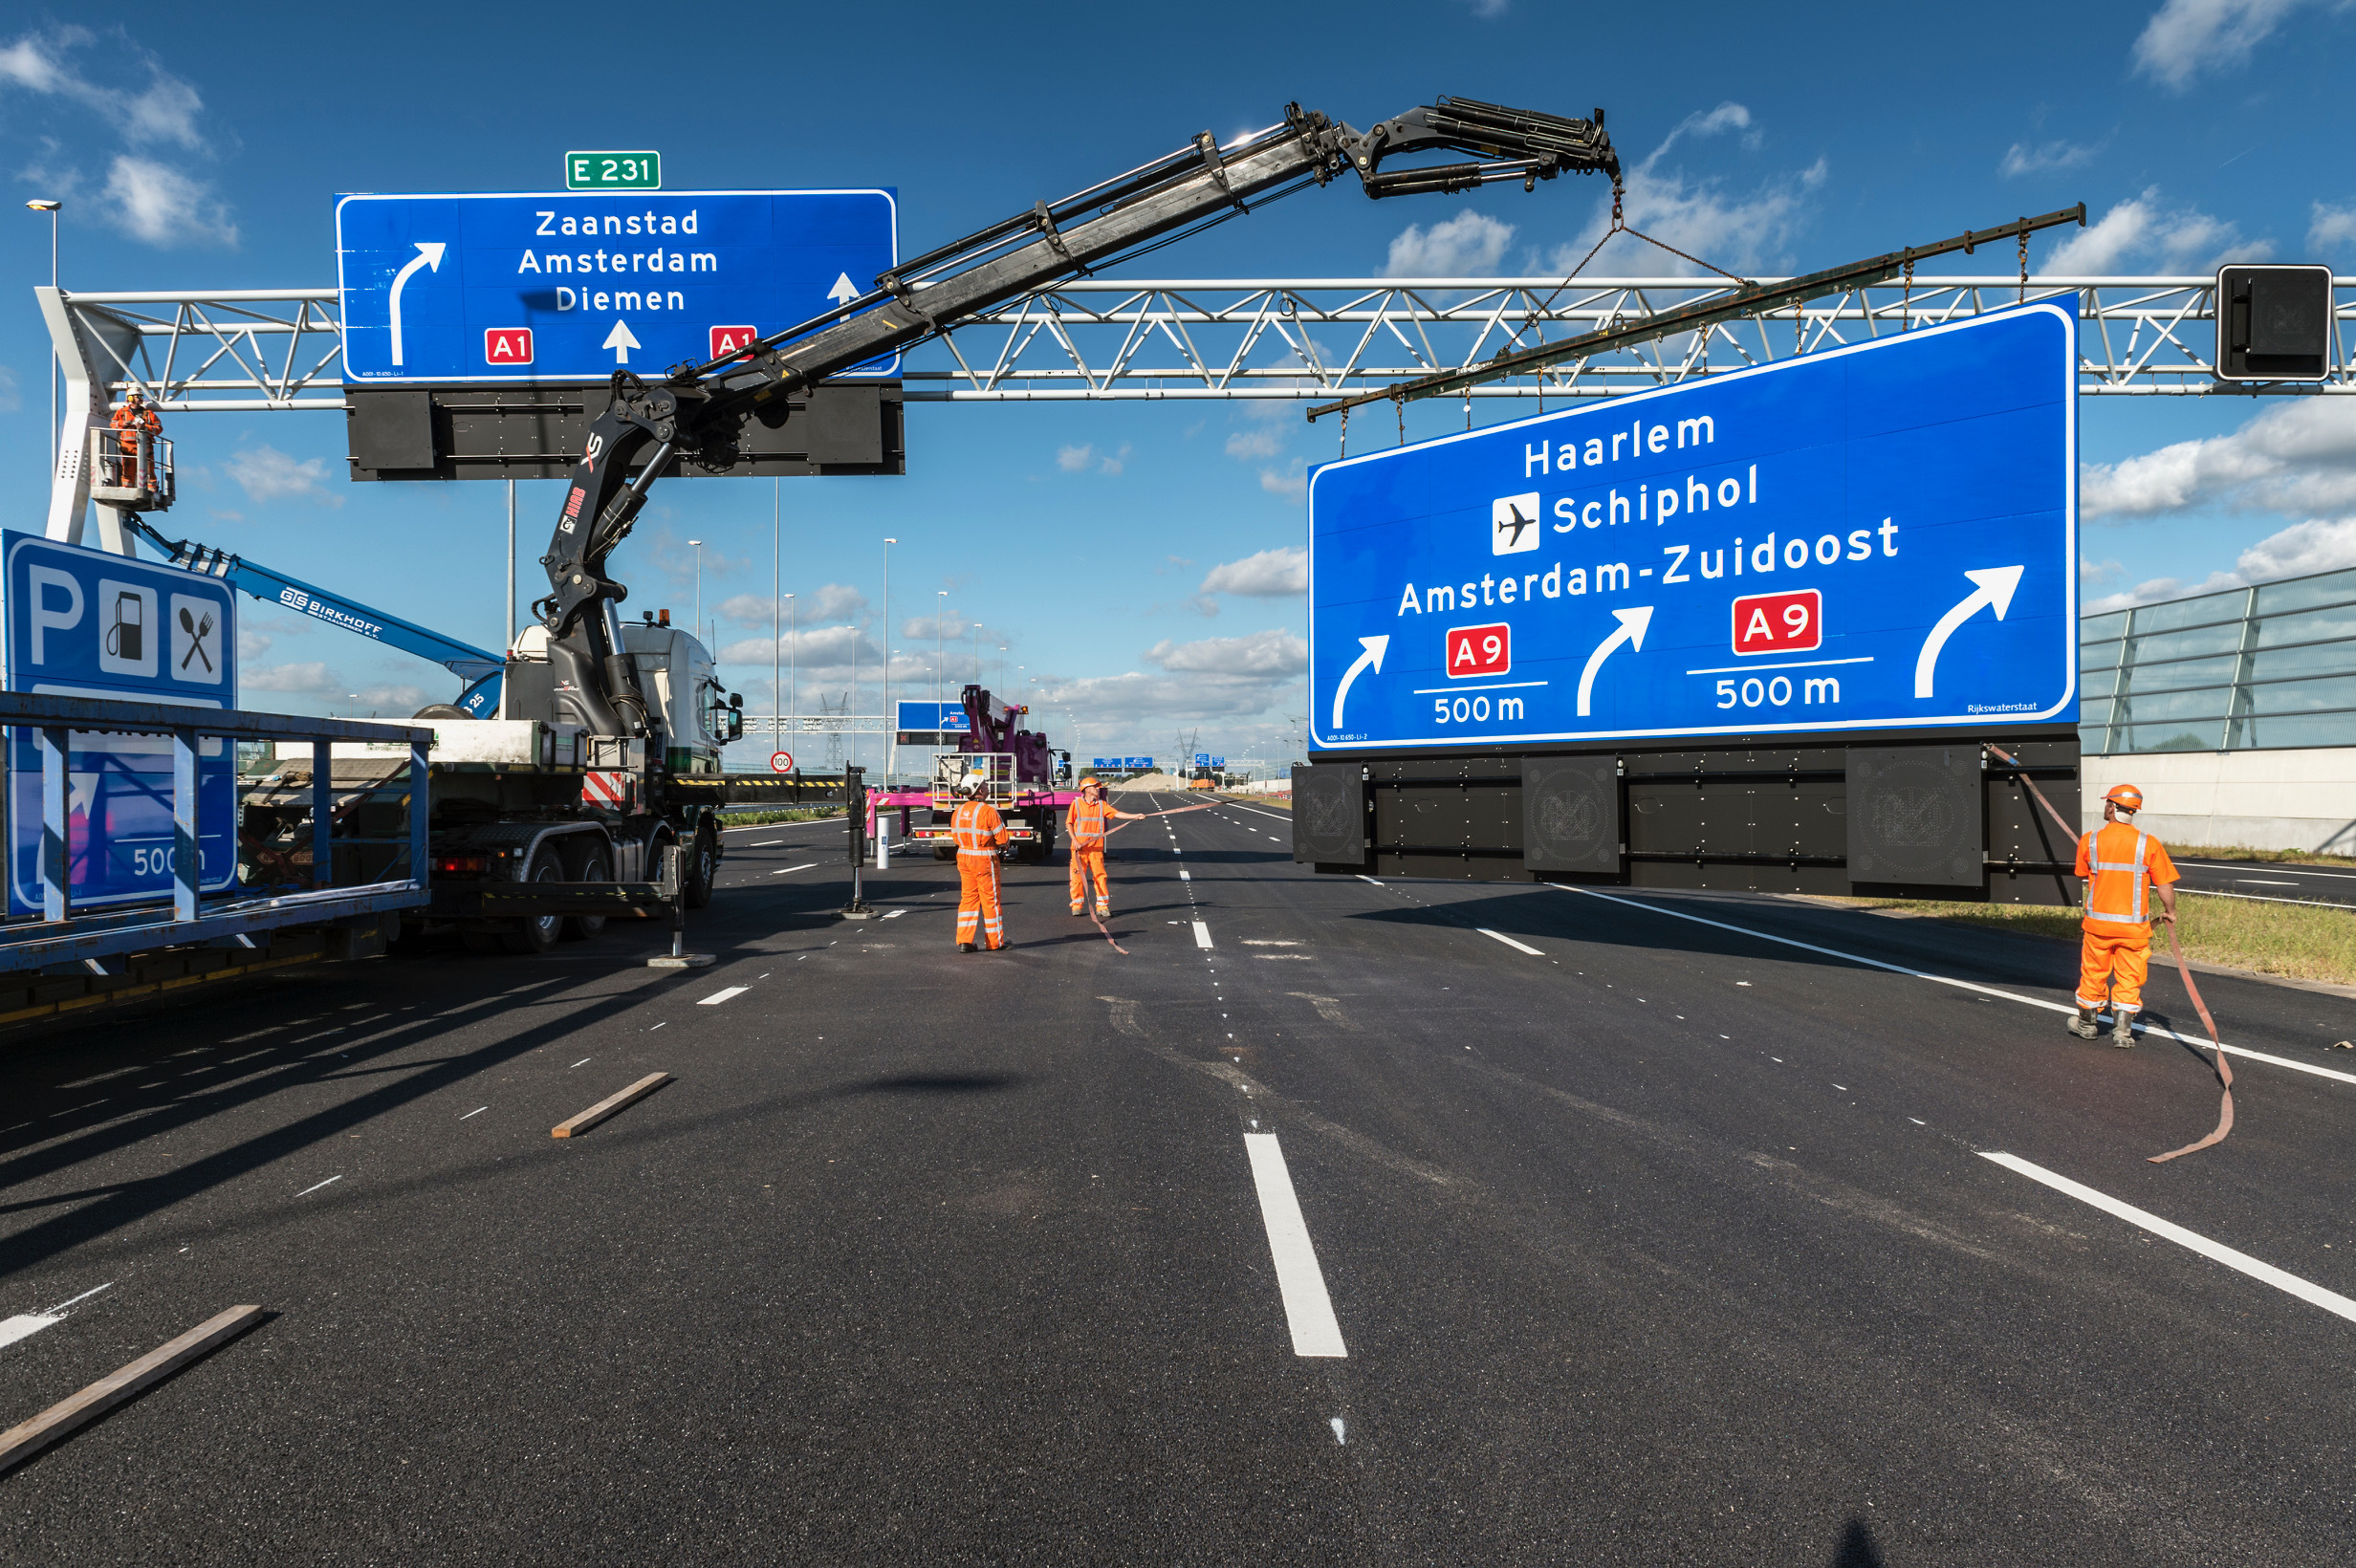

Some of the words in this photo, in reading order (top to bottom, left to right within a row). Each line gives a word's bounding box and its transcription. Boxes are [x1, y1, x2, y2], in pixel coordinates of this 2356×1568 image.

[574, 160, 592, 182] E
[600, 159, 649, 182] 231
[535, 208, 698, 236] Zaanstad
[517, 247, 717, 274] Amsterdam
[555, 286, 684, 311] Diemen
[493, 336, 527, 358] A1
[717, 334, 750, 355] A1
[579, 431, 603, 473] XS
[1524, 416, 1714, 479] Haarlem
[565, 487, 586, 518] HIAB
[1553, 465, 1758, 534] Schiphol
[1397, 517, 1900, 617] Amsterdam-Zuidoost
[29, 563, 84, 665] P
[309, 600, 383, 634] BIRKHOFF
[1743, 601, 1809, 642] A9
[1453, 635, 1501, 667] A9
[469, 692, 485, 709] 25
[1716, 677, 1793, 709] 500
[1804, 677, 1840, 706] m
[1434, 697, 1491, 724] 500
[1498, 698, 1524, 721] m
[1967, 701, 2039, 717] Rijkswaterstaat
[774, 757, 789, 767] 100
[134, 847, 176, 876] 500
